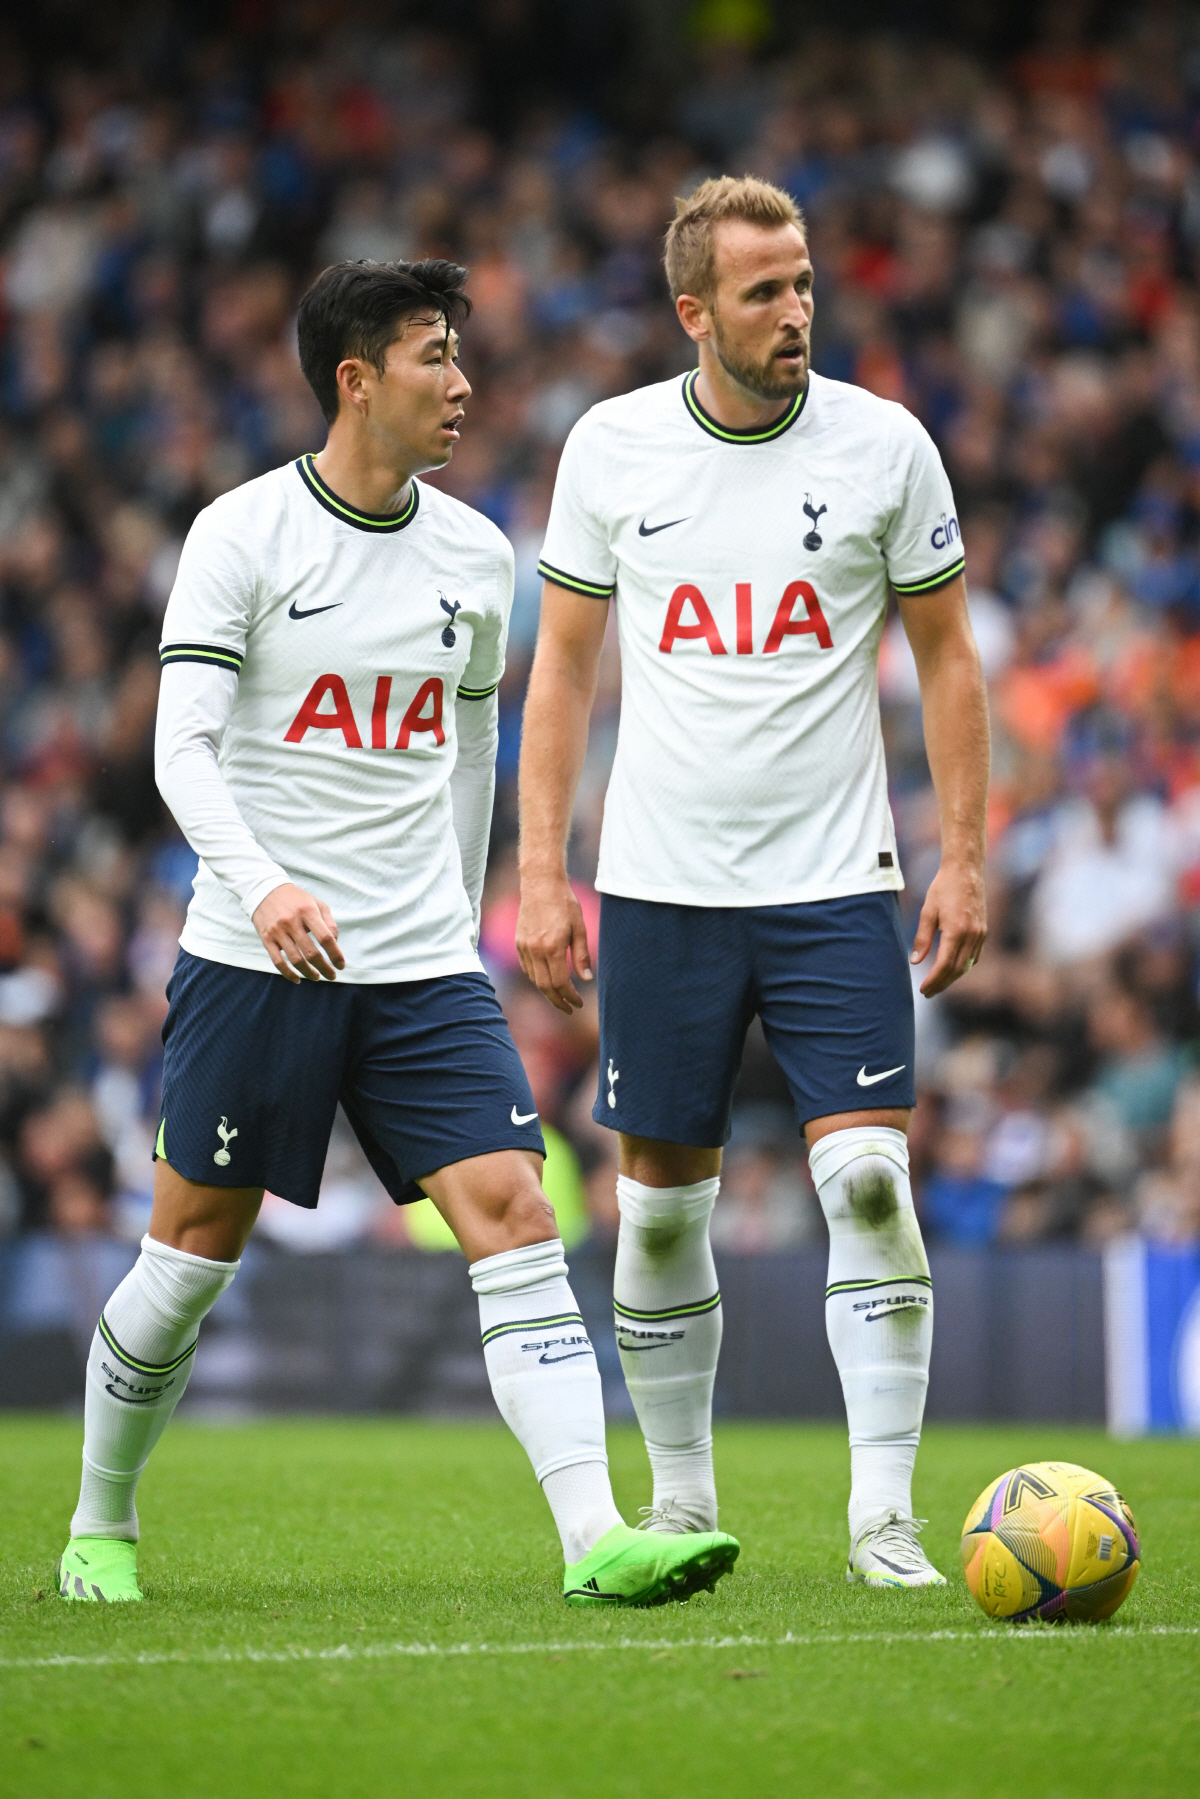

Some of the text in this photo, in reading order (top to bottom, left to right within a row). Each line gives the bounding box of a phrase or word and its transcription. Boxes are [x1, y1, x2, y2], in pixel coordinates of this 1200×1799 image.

[659, 580, 834, 655] AIA
[283, 674, 445, 749] AIA
[852, 1295, 928, 1312] SPURS
[101, 1361, 176, 1394] SPURS
